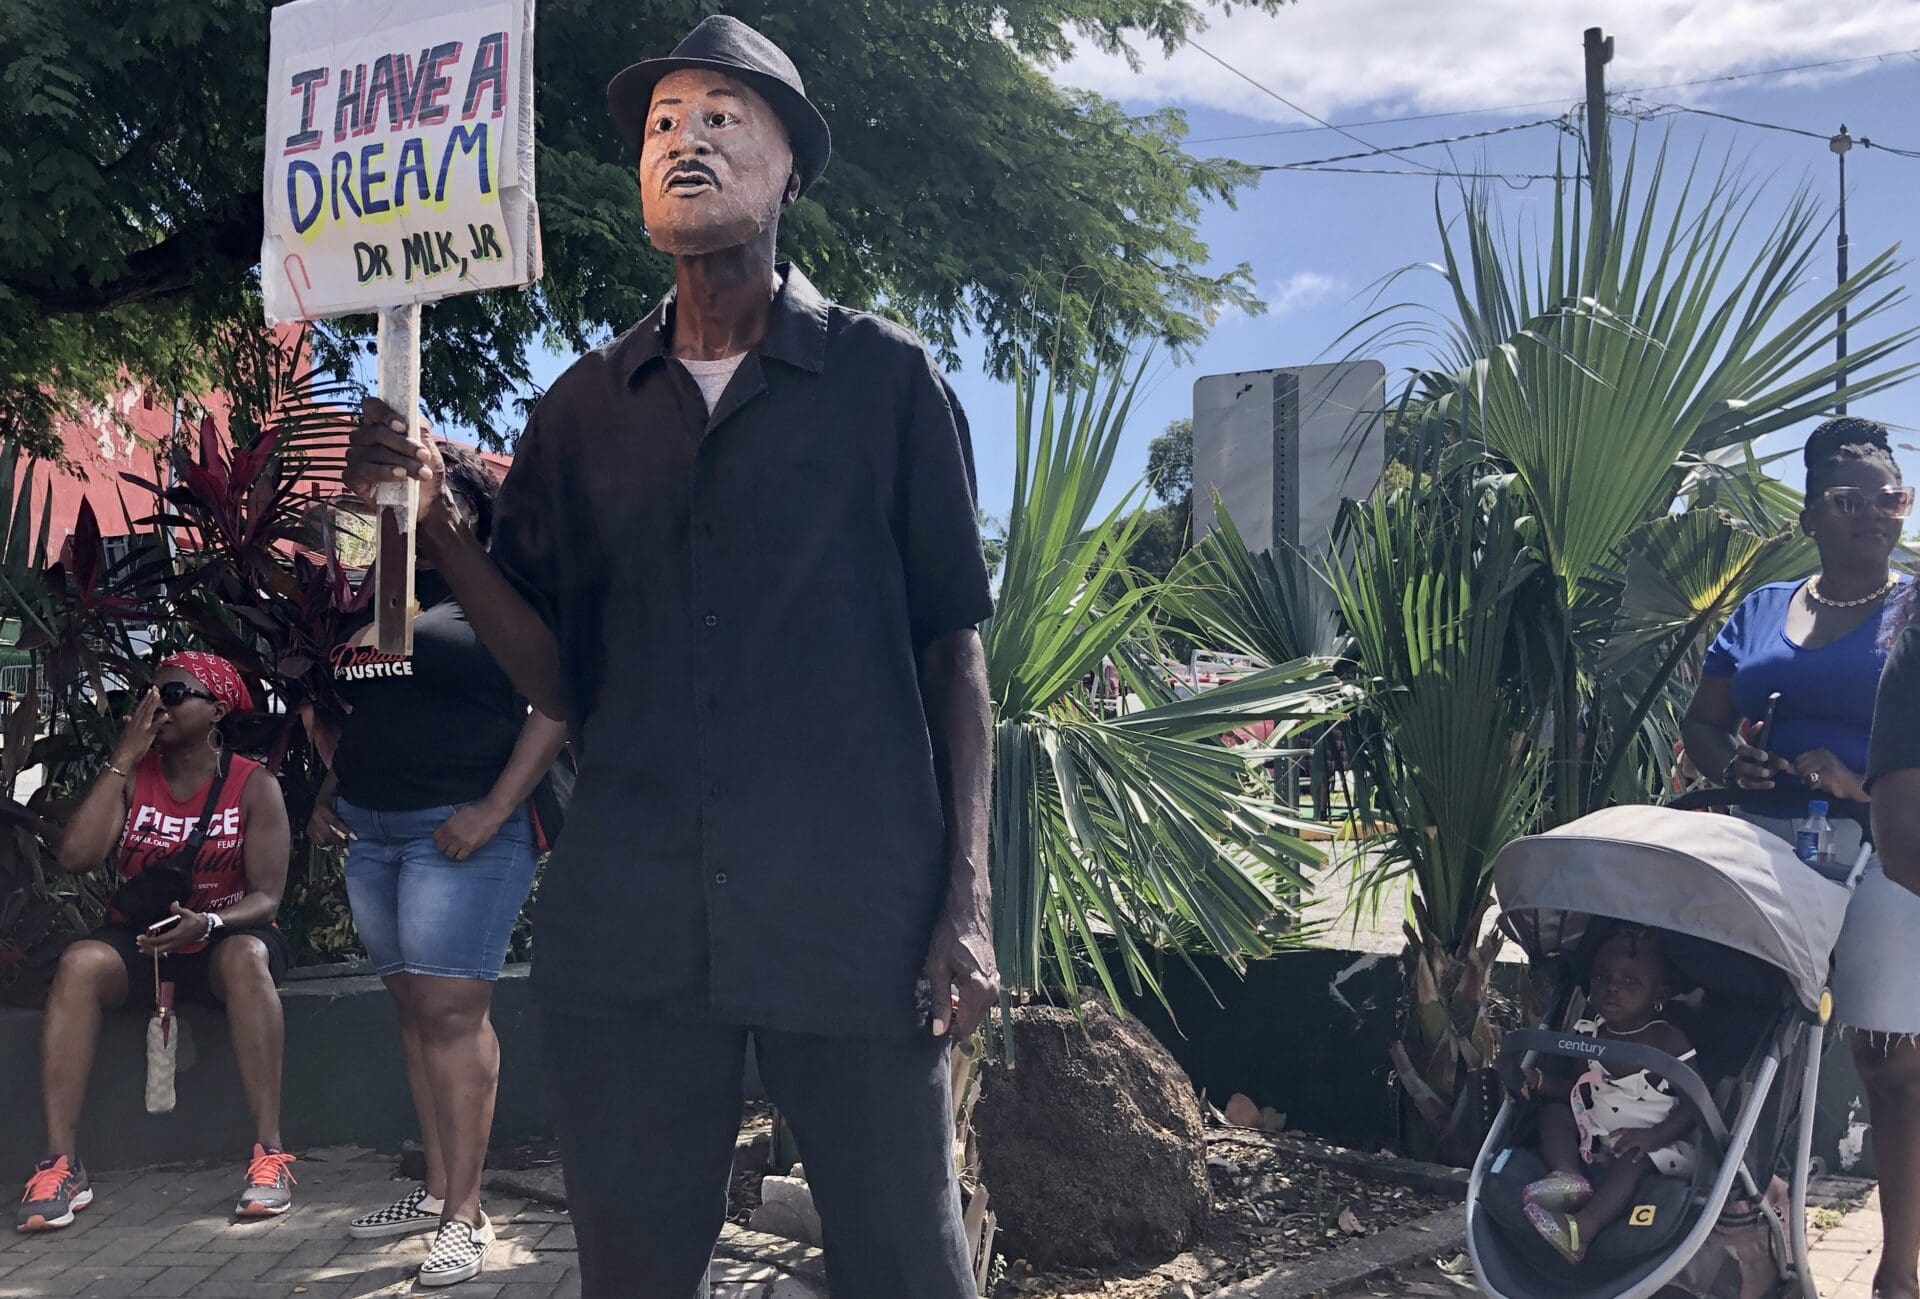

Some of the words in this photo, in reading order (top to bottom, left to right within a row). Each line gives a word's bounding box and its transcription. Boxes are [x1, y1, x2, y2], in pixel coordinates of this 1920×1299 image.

[284, 67, 329, 155] I
[335, 41, 463, 143] HAVE
[461, 31, 509, 121] A
[286, 122, 493, 236] DREAM
[353, 241, 394, 284] DR
[402, 231, 468, 283] MLK,
[467, 223, 503, 261] JR
[345, 661, 414, 681] JUSTICE
[130, 834, 170, 848] FAULOUS
[1558, 1038, 1606, 1056] century
[1636, 1208, 1650, 1222] C
